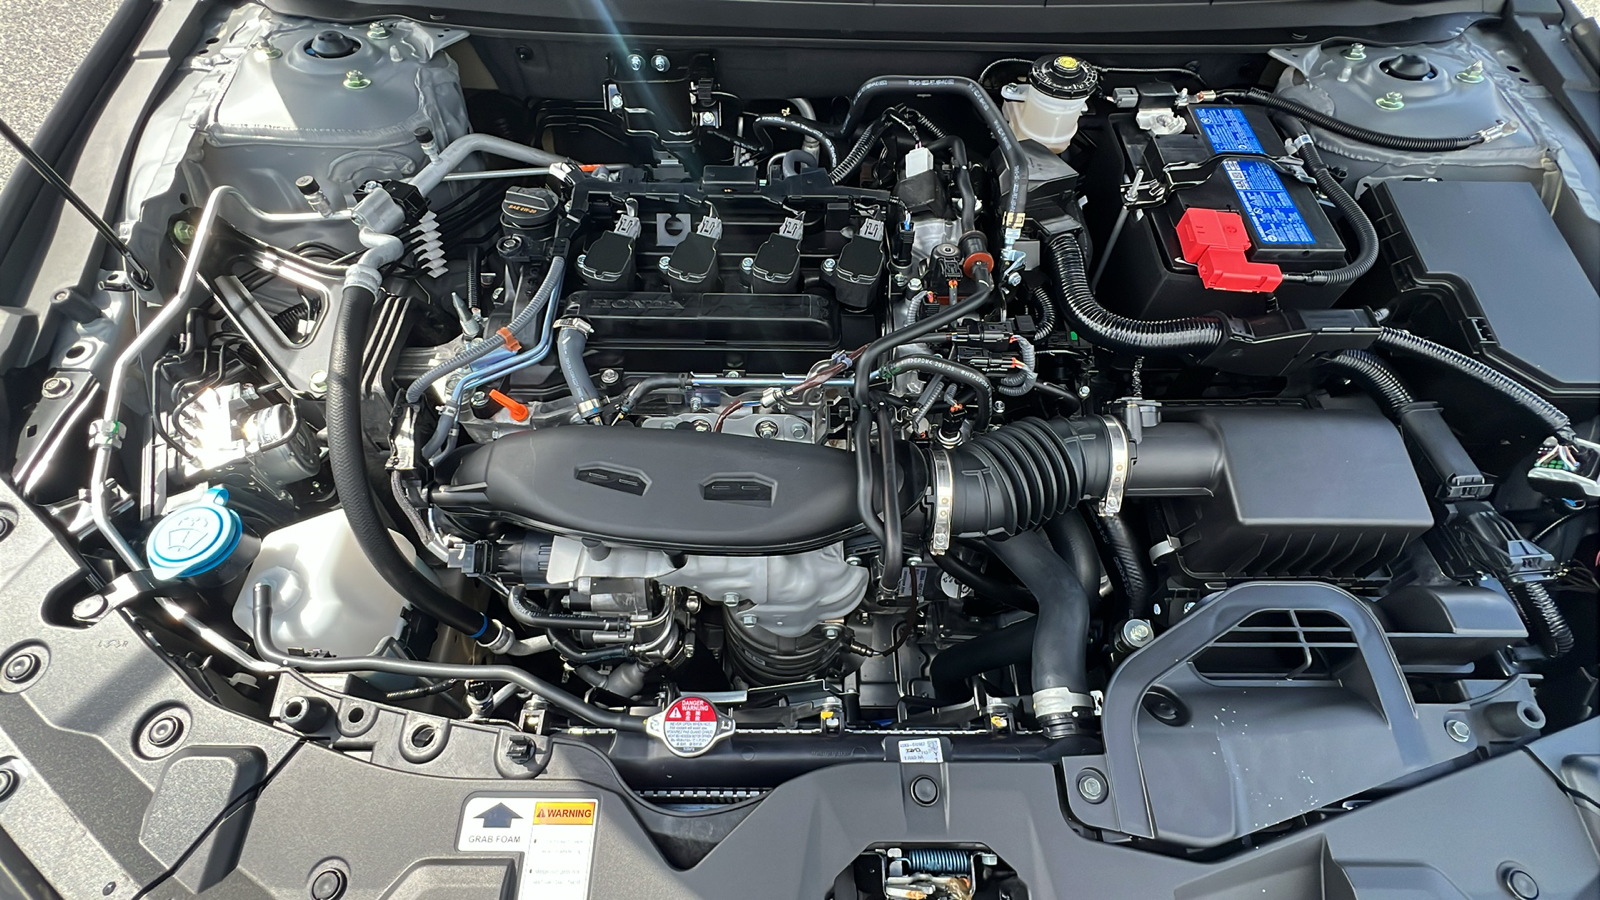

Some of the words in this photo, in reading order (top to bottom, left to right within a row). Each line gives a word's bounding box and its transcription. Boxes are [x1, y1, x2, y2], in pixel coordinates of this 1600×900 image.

[547, 809, 592, 818] WARNING
[468, 835, 493, 843] GRAB
[495, 835, 521, 843] FOAM
